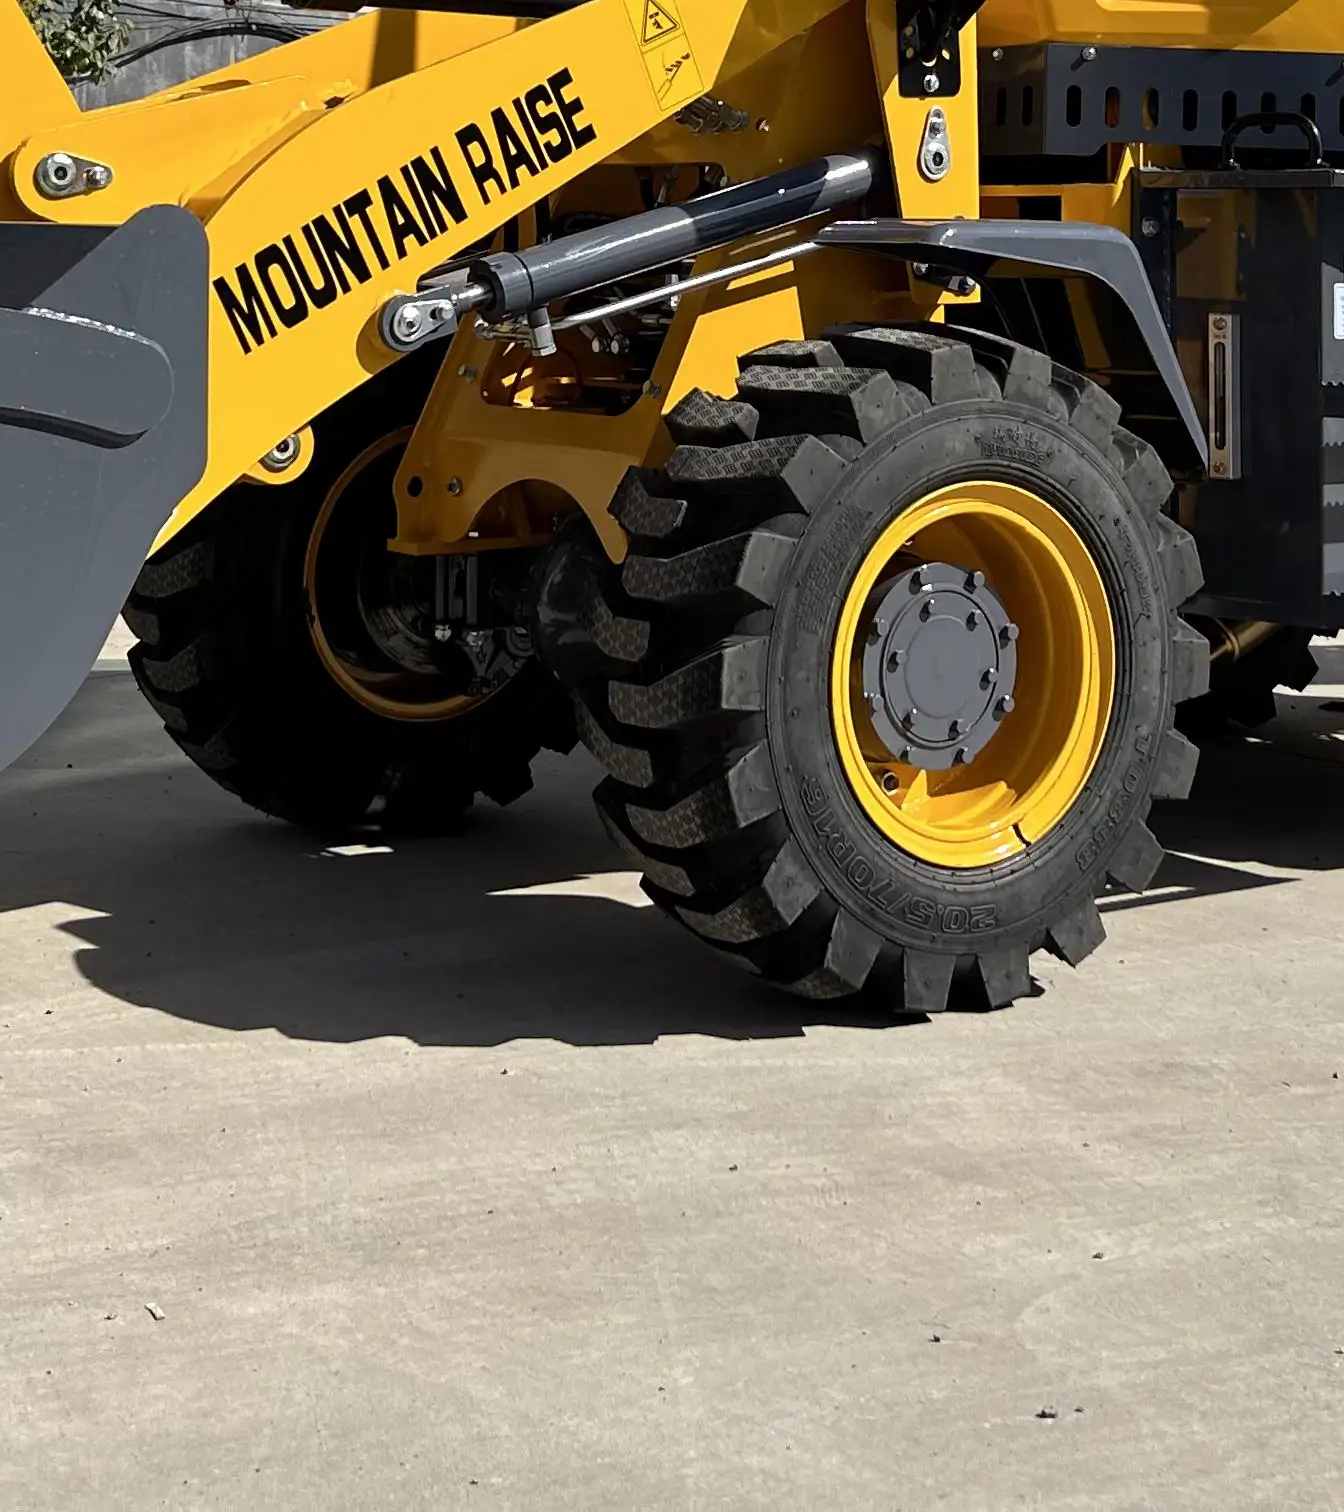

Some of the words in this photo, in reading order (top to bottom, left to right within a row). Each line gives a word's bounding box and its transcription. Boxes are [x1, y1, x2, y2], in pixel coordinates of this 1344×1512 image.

[212, 146, 468, 355] MOUNTAIN
[454, 67, 597, 205] RAISE
[800, 776, 996, 933] 20.5/70R16
